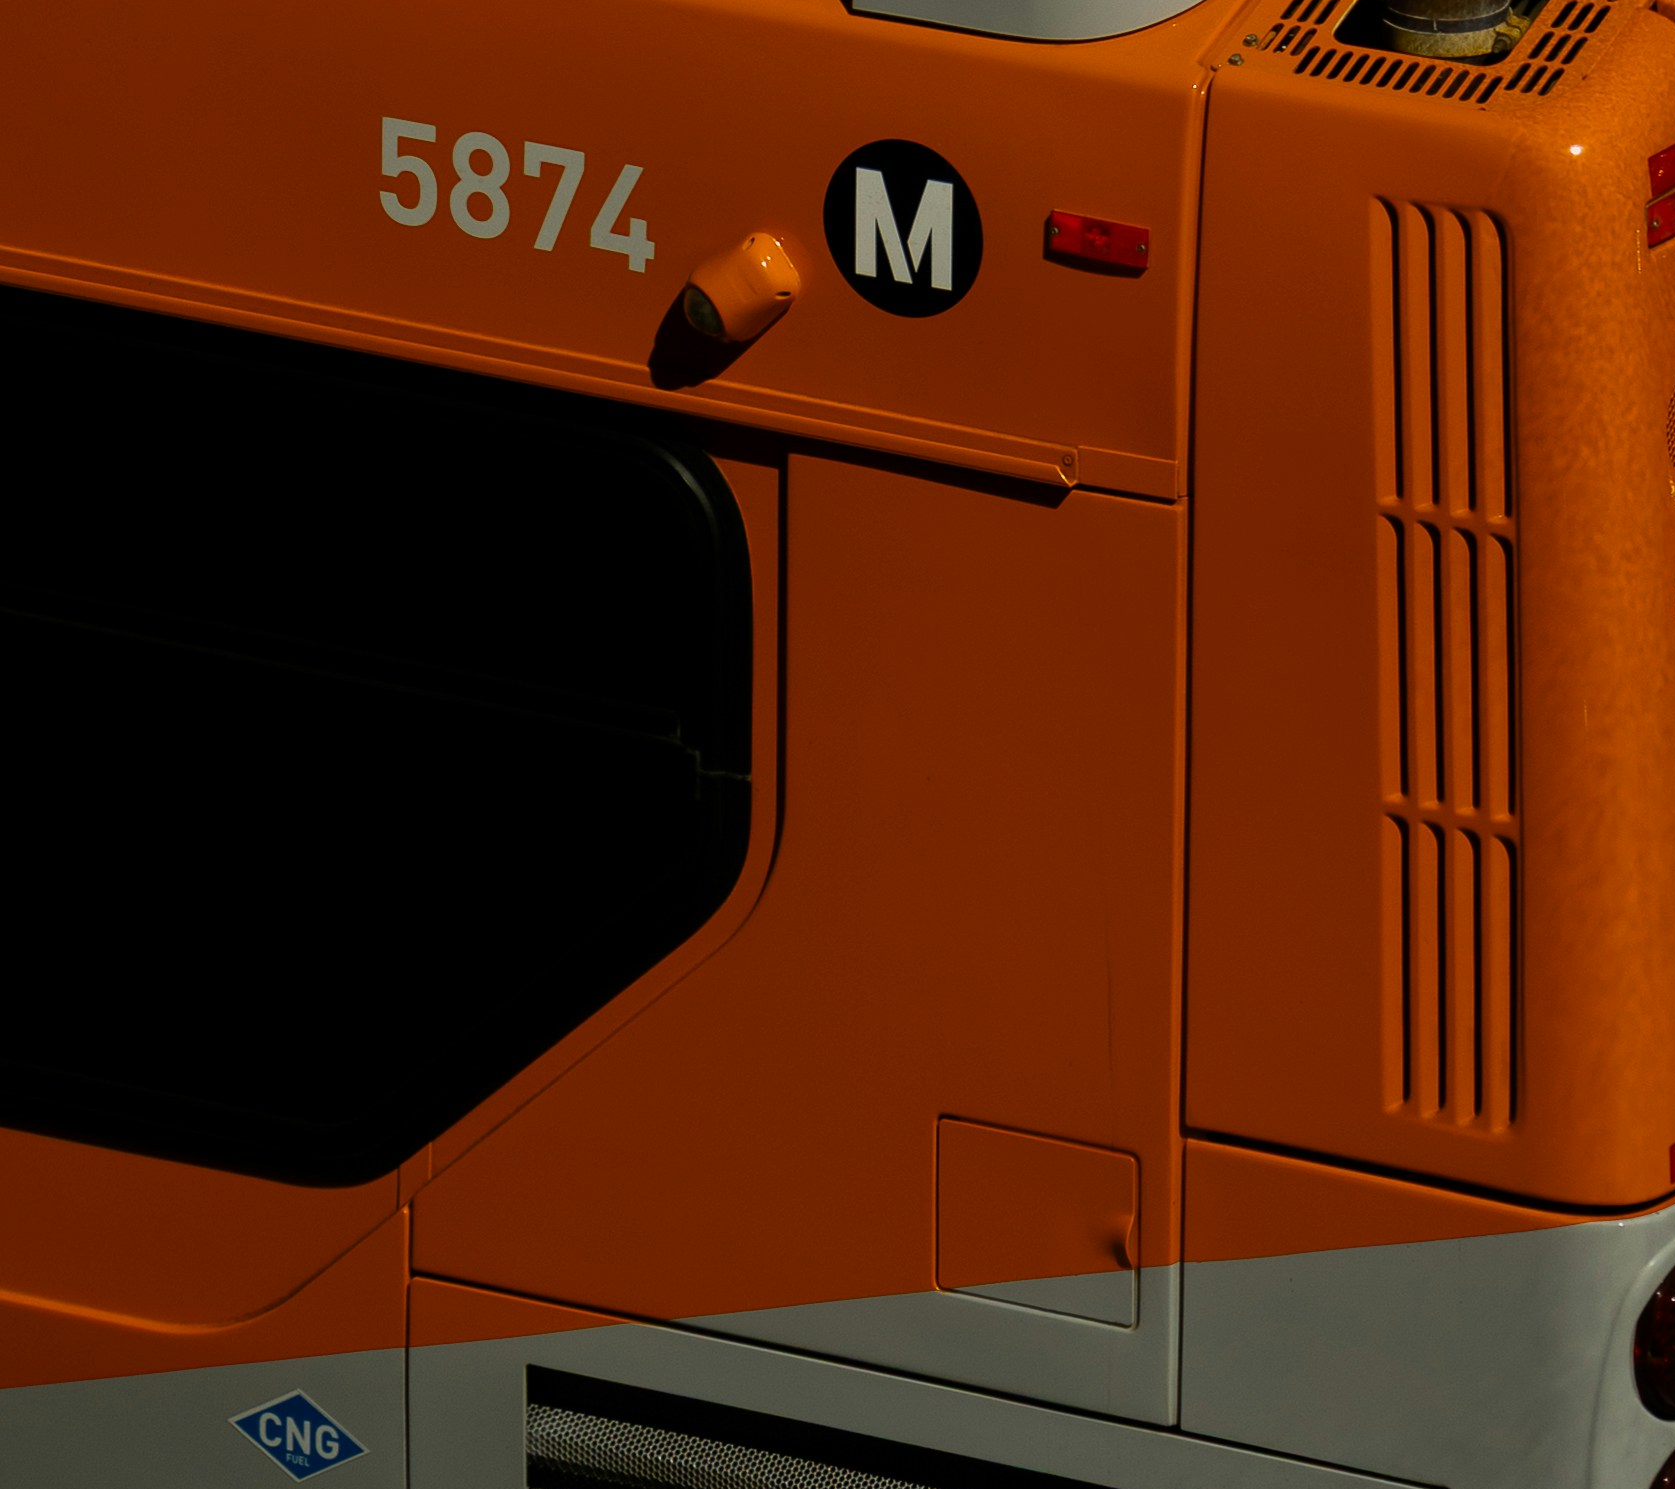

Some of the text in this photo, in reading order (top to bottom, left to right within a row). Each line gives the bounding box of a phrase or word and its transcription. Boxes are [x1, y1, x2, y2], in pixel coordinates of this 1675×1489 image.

[379, 116, 655, 273] 5874
[854, 166, 954, 291] M
[259, 1412, 339, 1460] CNG
[286, 1453, 310, 1467] FUEL
